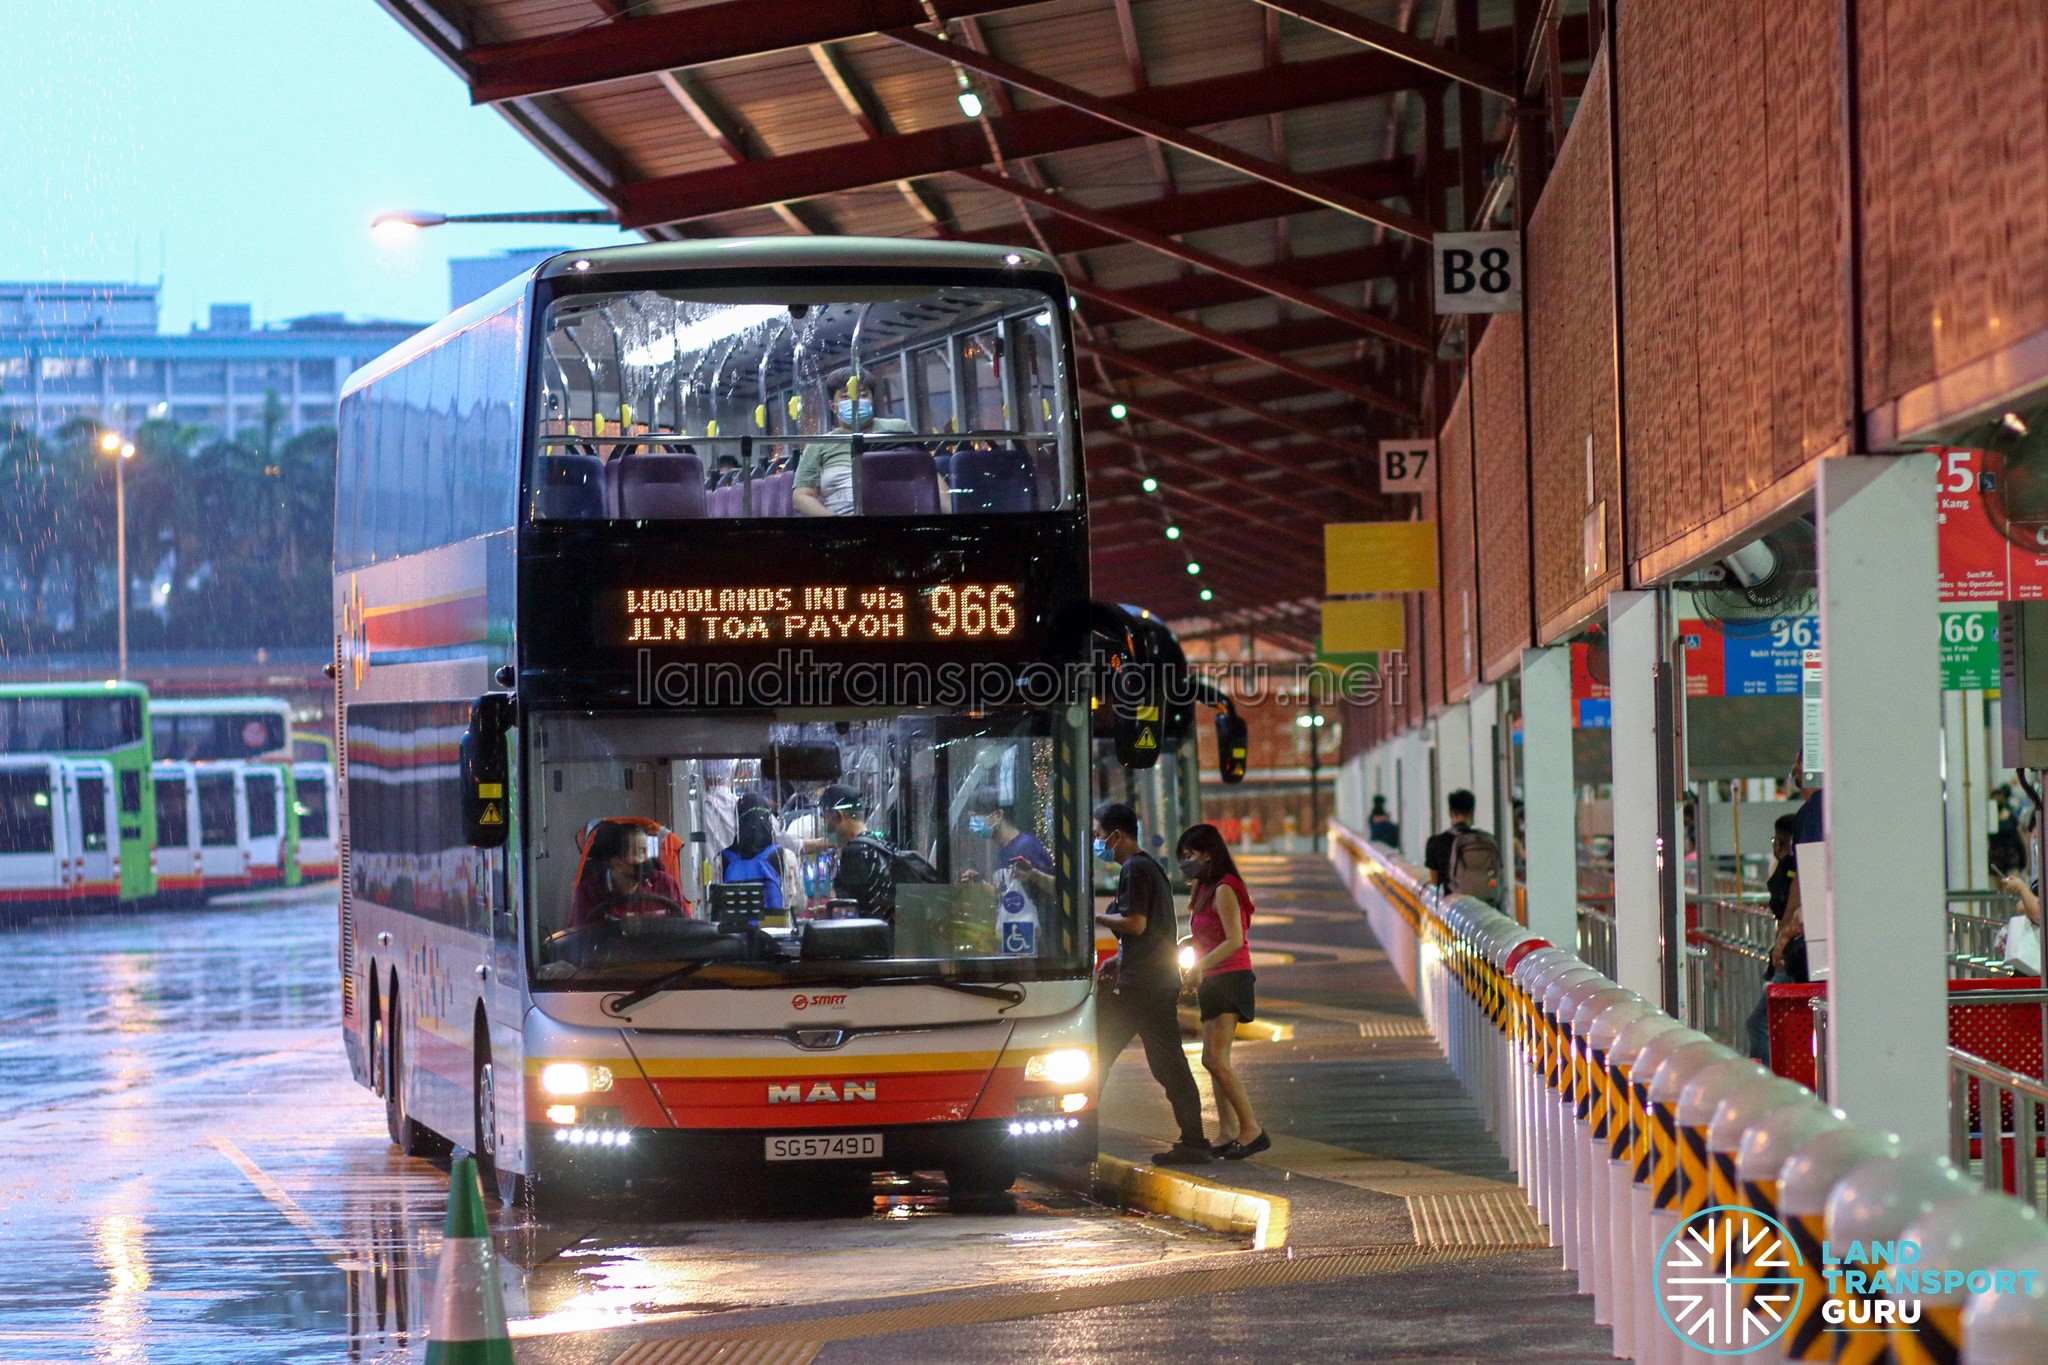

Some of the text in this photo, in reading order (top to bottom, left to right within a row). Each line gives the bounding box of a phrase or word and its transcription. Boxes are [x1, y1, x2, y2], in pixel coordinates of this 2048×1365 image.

[1442, 248, 1512, 294] B8
[1385, 450, 1428, 481] B7
[1942, 499, 1969, 510] Kang
[1969, 580, 2004, 589] Operation
[1969, 590, 2004, 599] Operation
[625, 584, 1018, 637] WOODLANDS INT via 966
[627, 614, 905, 641] JLN TOA PAYOH
[1938, 614, 1984, 642] 66
[811, 995, 847, 1005] SMRT
[767, 1081, 876, 1104] MAN
[773, 1138, 875, 1158] SG5749D
